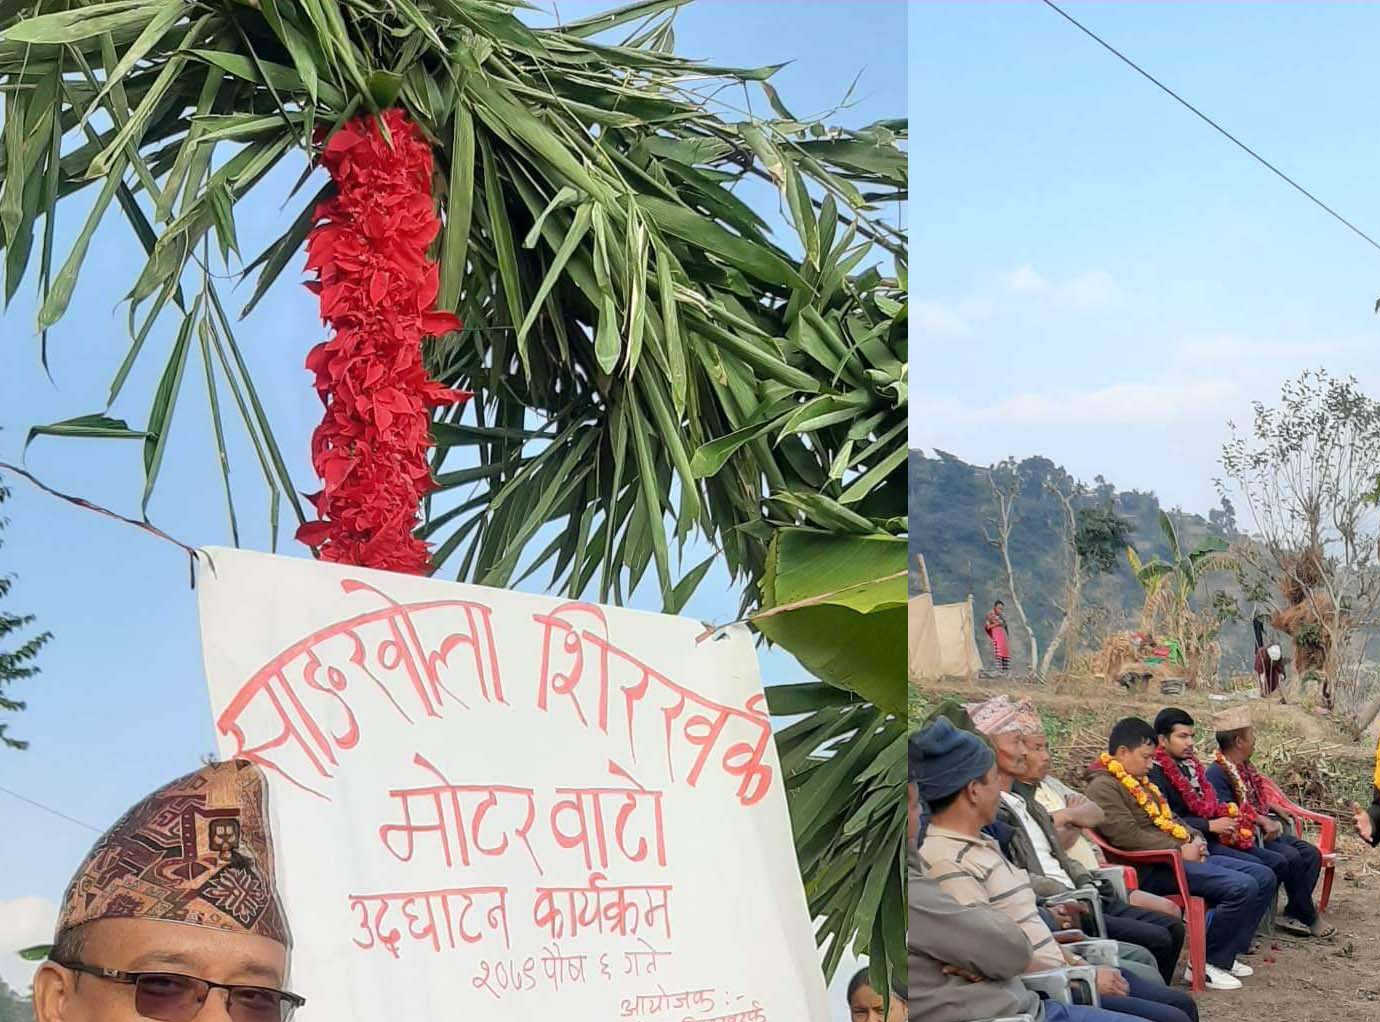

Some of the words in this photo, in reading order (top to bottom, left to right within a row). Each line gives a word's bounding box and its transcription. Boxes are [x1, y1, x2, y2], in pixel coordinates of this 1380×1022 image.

[380, 753, 543, 875] मोटर
[533, 872, 673, 940] कार्यक्रम
[472, 957, 537, 998] २०७९
[599, 953, 612, 980] ६
[624, 938, 672, 976] गते
[620, 984, 715, 1017] आयोजक
